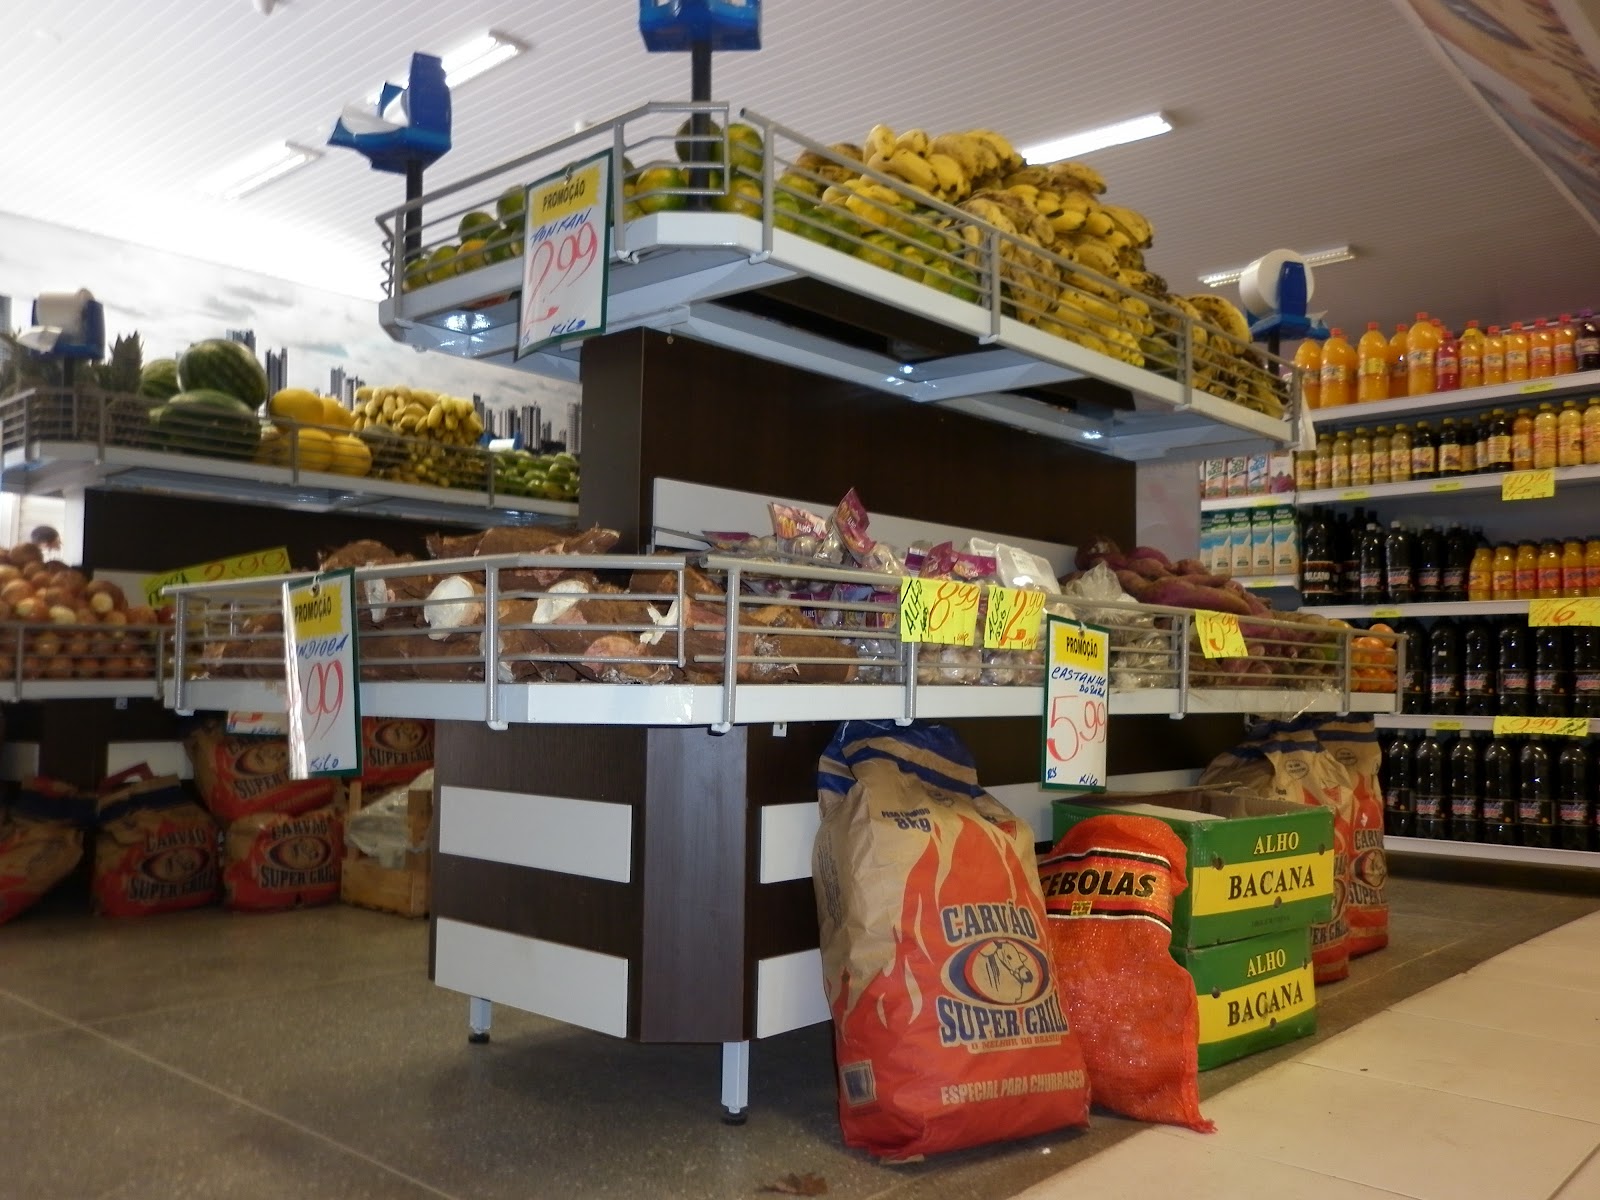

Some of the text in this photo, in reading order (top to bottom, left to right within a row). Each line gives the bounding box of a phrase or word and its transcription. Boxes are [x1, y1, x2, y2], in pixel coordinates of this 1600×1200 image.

[542, 180, 586, 212] PROMOÇÃO
[293, 599, 333, 623] PROMOÇÃO
[1065, 636, 1099, 661] PROMOÇÃO
[1253, 831, 1300, 855] ALHO
[1228, 864, 1316, 900] BACANA
[942, 901, 1038, 943] CARVÃO
[1246, 948, 1287, 978] ALHO
[936, 984, 1068, 1044] SUPER GRILL
[1227, 979, 1304, 1028] BACANA
[940, 1069, 1085, 1106] ESPECIAL PARA CHURRASCO
